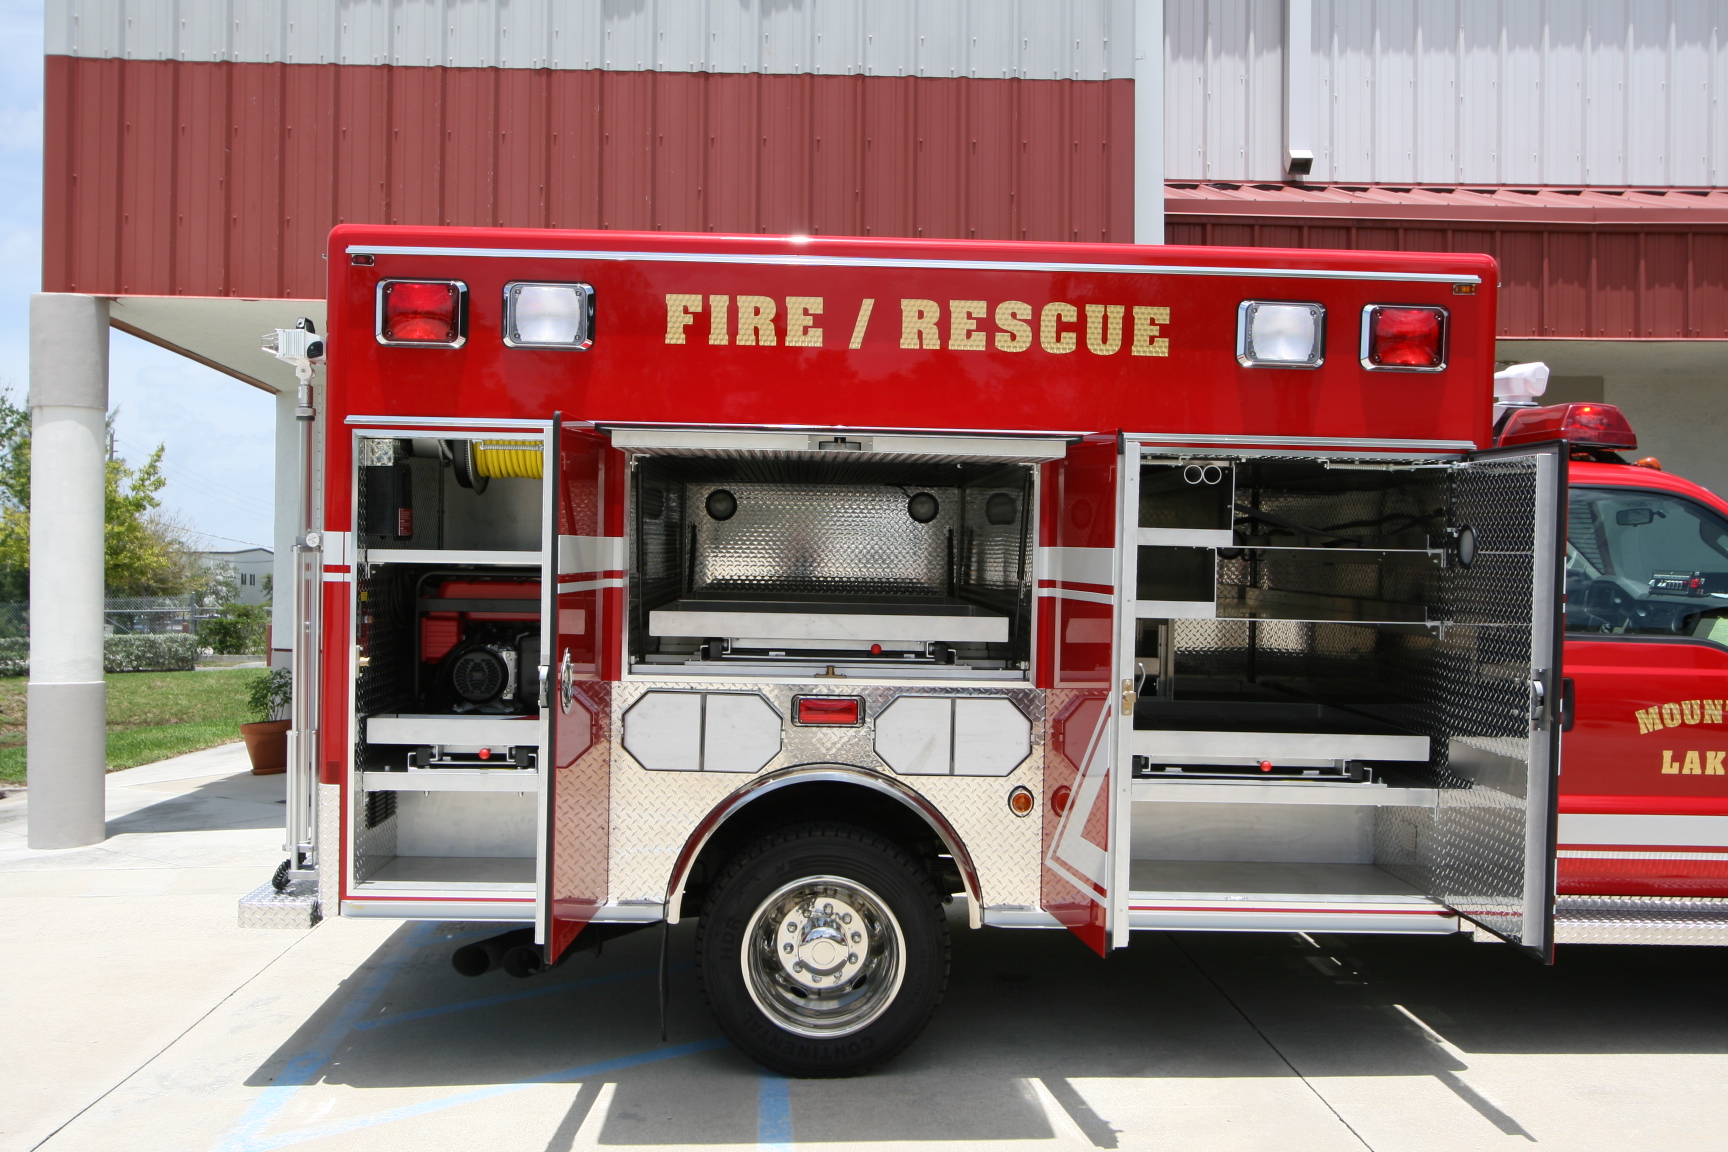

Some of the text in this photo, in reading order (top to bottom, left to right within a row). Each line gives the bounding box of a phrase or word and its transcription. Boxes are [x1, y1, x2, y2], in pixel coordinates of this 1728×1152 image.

[665, 294, 1171, 357] FIRE / RESCUE
[1635, 699, 1728, 735] MOUN
[1661, 750, 1726, 776] LAK
[740, 1010, 876, 1061] CONTINENTAL
